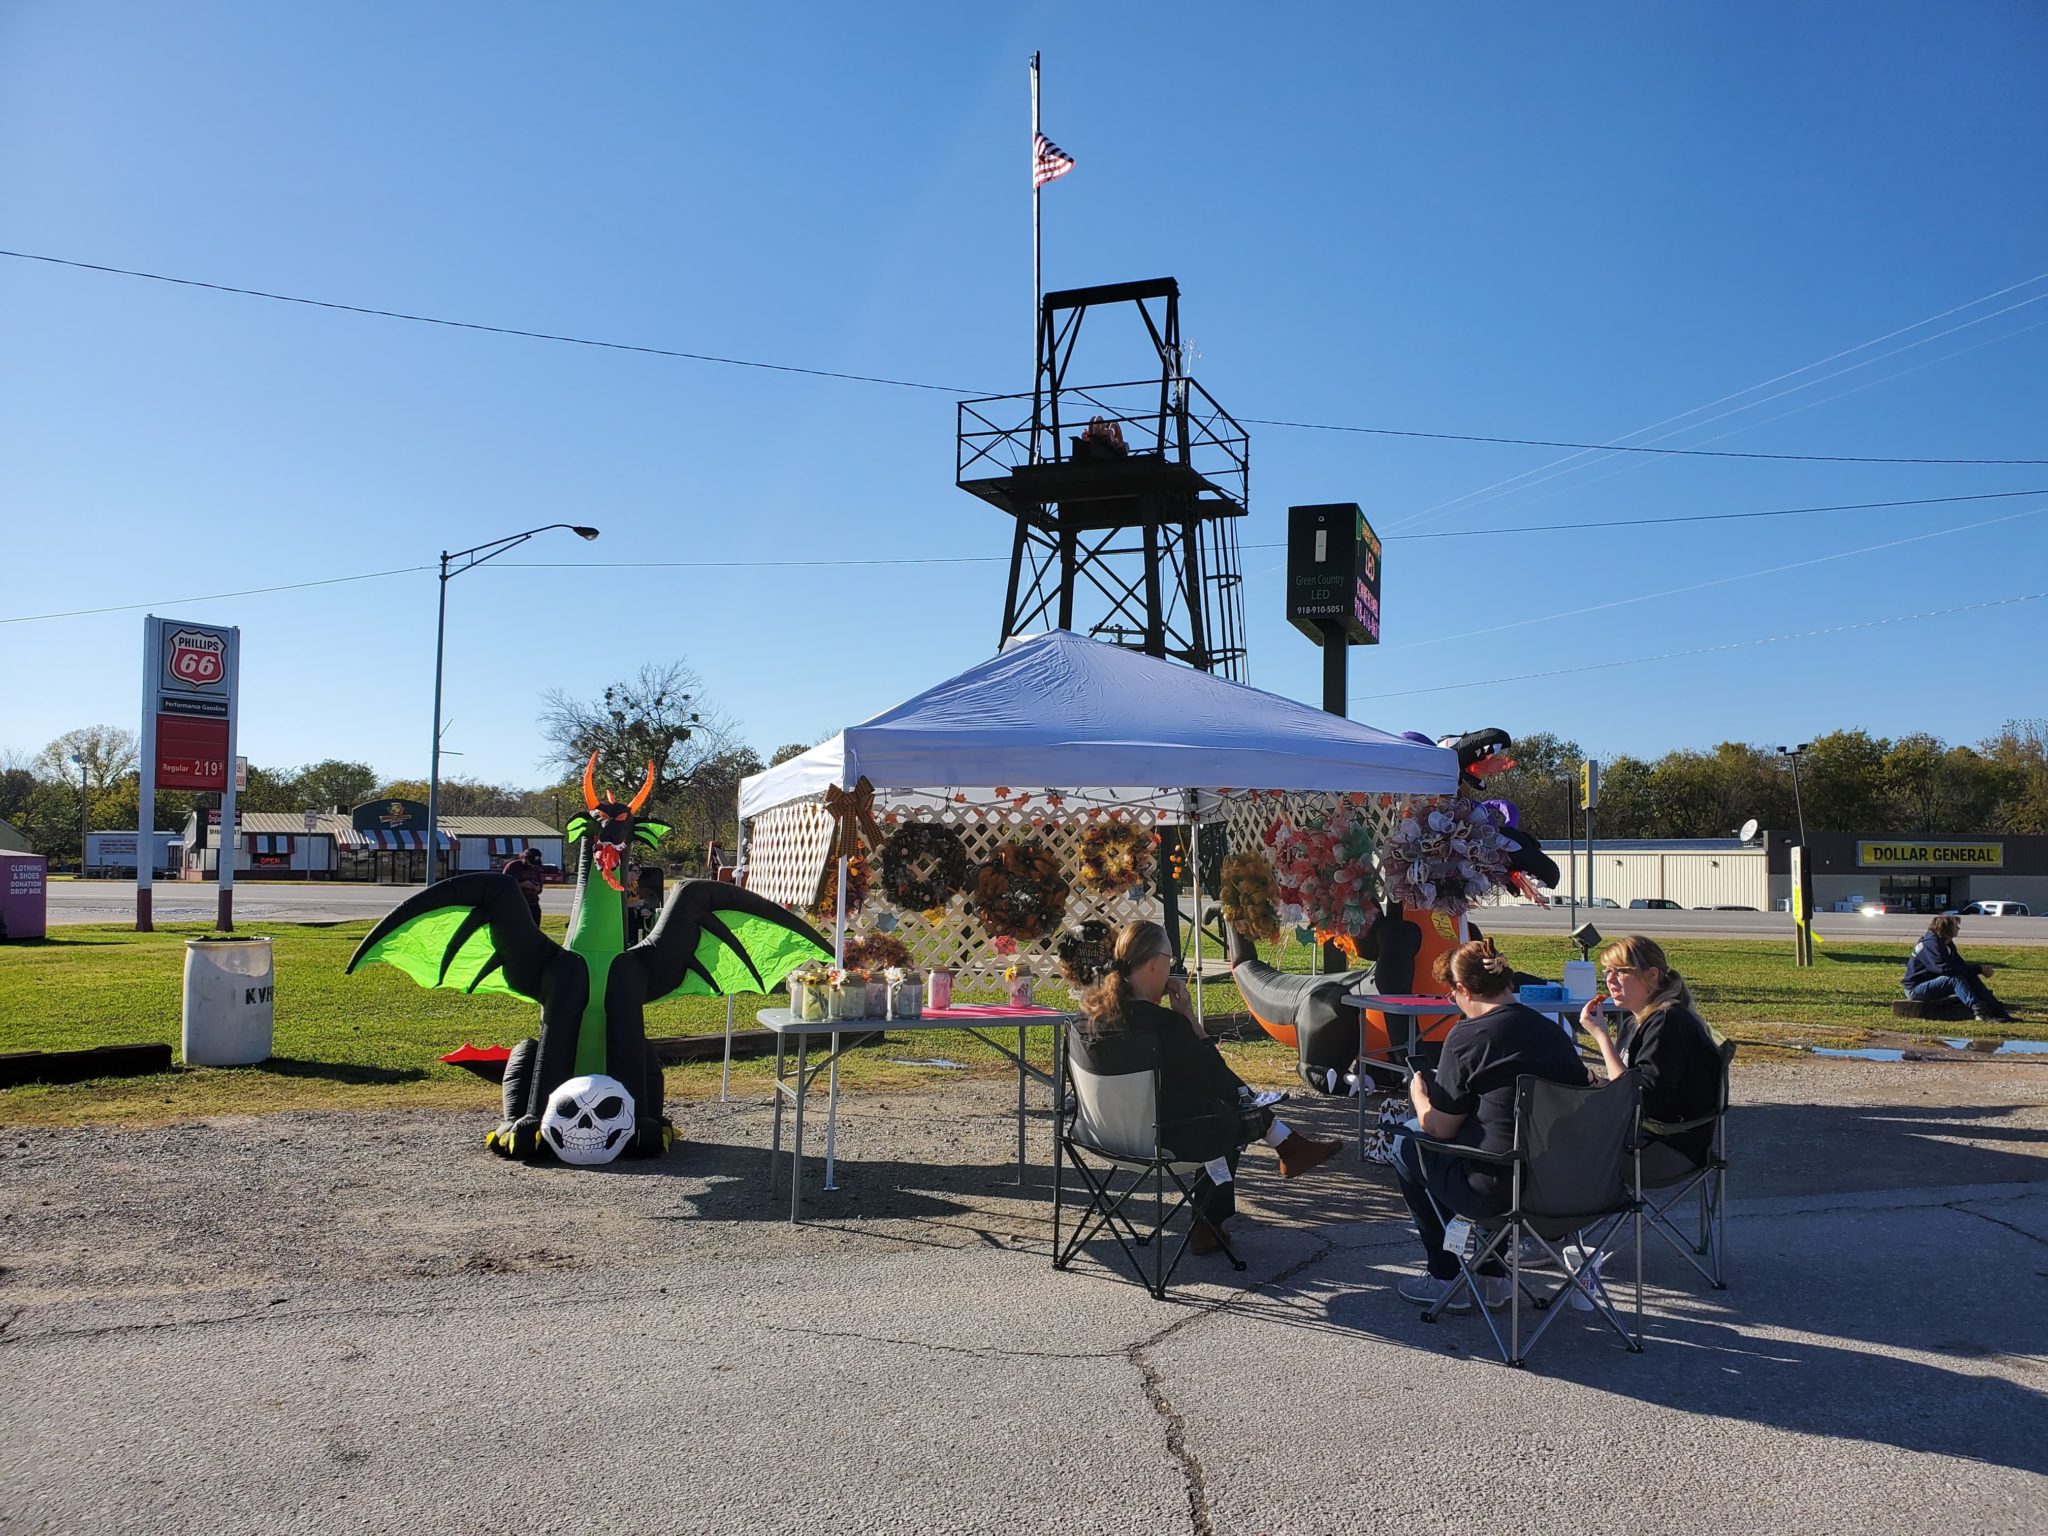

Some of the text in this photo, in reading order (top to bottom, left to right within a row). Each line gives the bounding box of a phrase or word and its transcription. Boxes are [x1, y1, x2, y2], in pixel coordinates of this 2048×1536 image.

[1295, 574, 1345, 587] Green Country
[1311, 589, 1330, 600] LED
[1297, 605, 1344, 615] 918-910-5051
[178, 637, 219, 651] PHILLIPS
[180, 653, 217, 675] 66
[165, 701, 226, 712] Performance Gasoline
[162, 763, 189, 773] Regular
[1872, 847, 1994, 862] DOLLAR GENERAL
[13, 872, 40, 880] & SHOES
